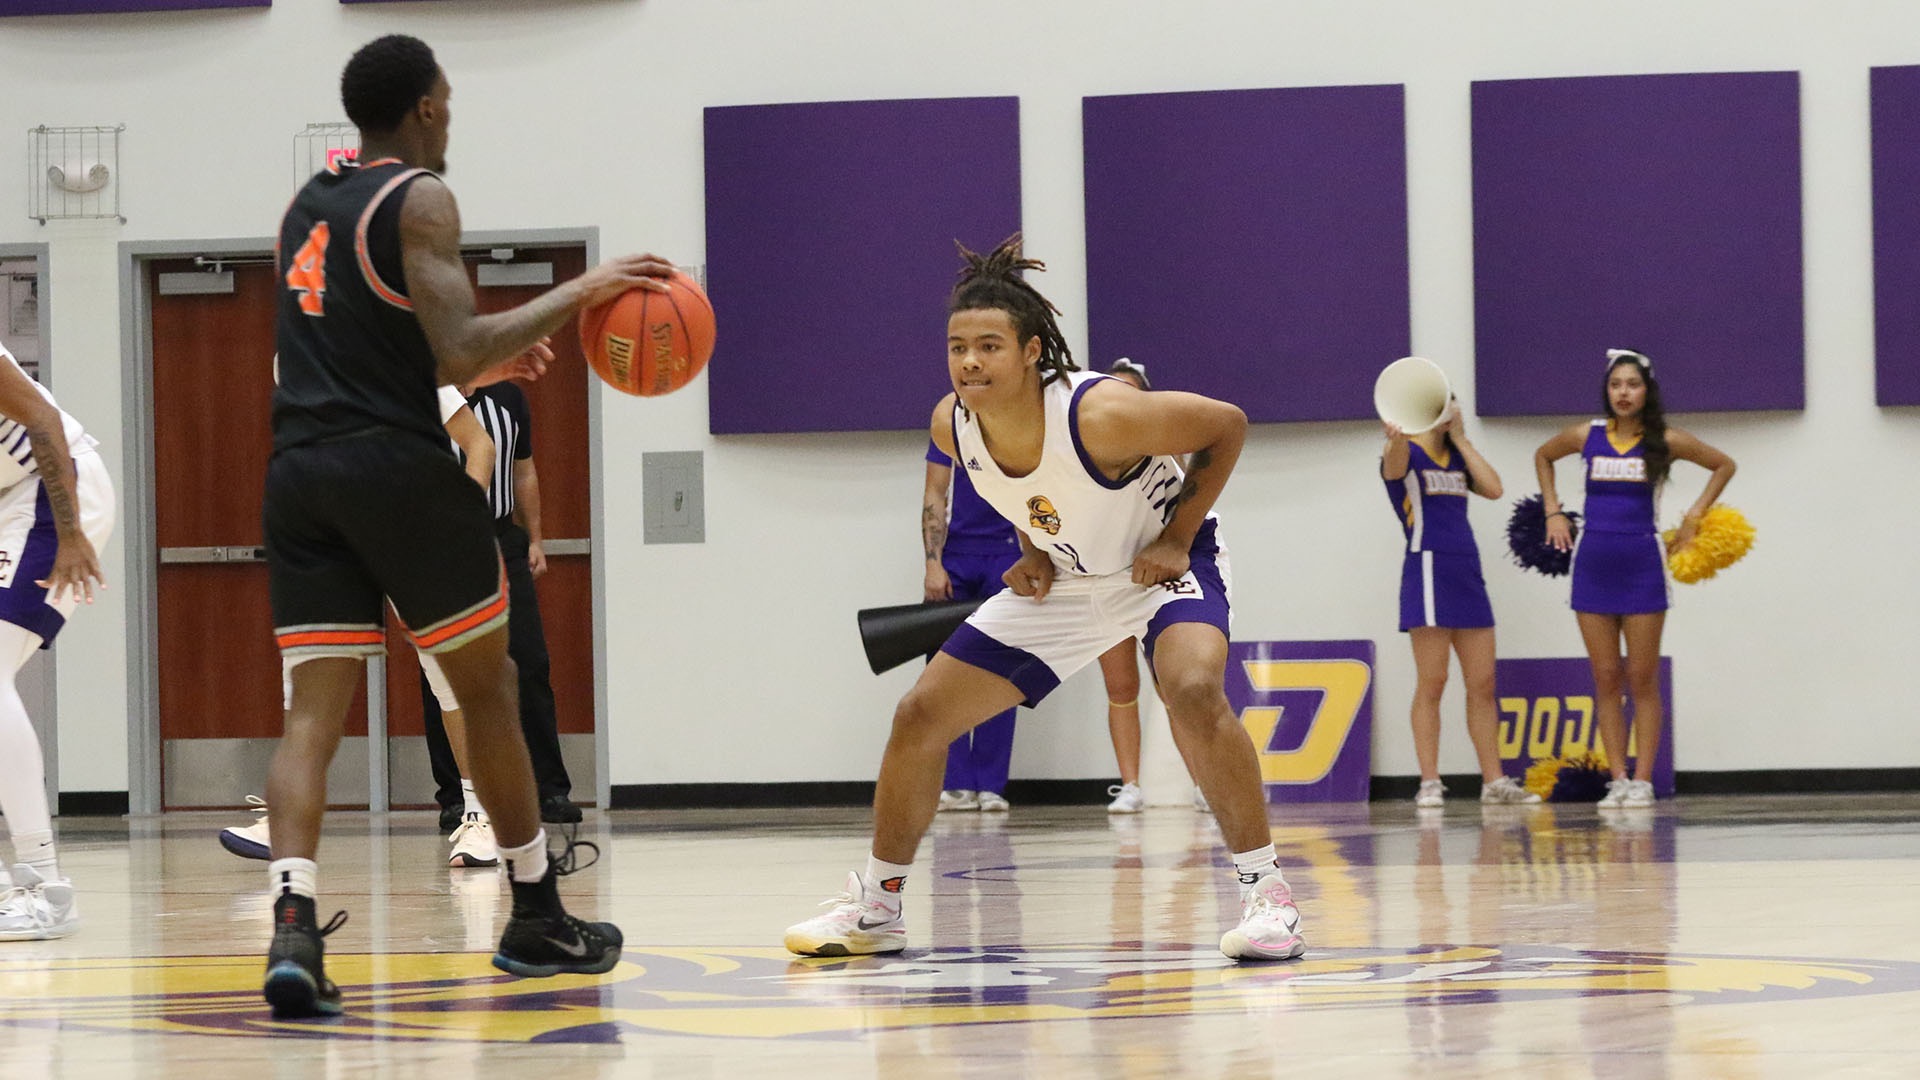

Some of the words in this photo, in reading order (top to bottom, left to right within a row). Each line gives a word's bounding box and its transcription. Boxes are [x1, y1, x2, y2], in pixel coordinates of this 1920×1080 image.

[286, 220, 330, 317] 4
[1422, 469, 1468, 496] DODG
[1240, 659, 1371, 785] D
[1498, 696, 1638, 760] DOD
